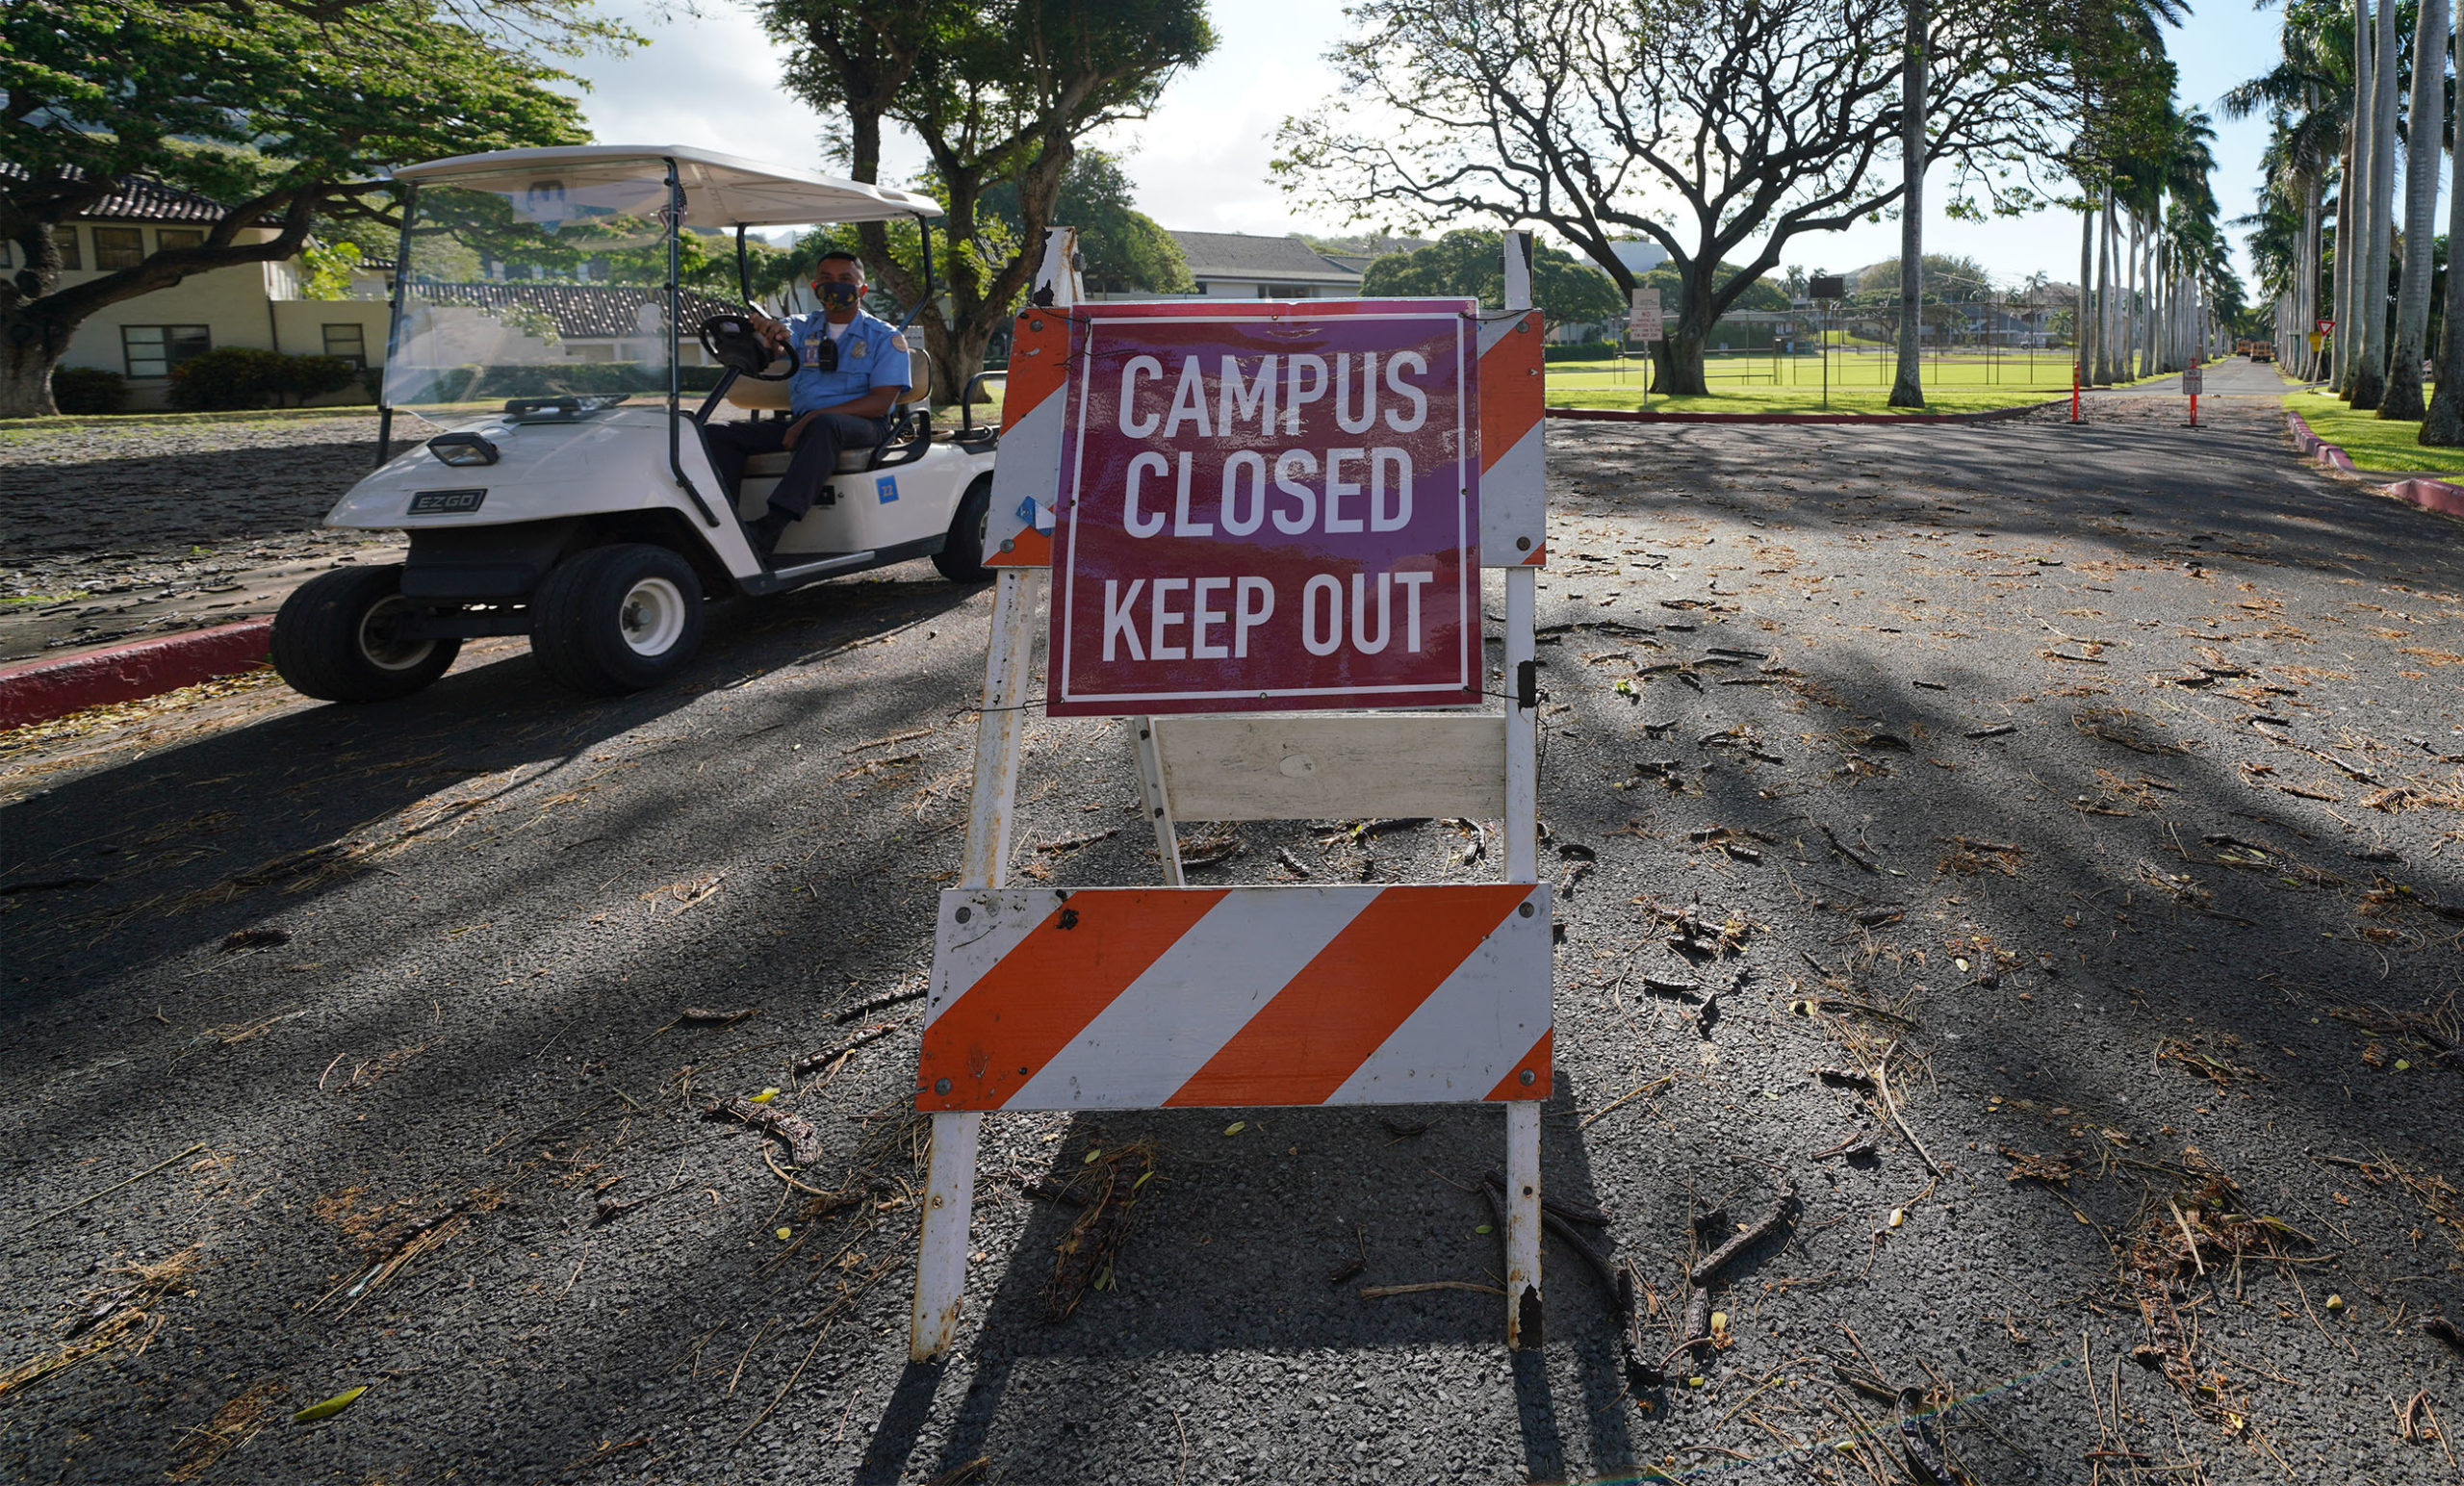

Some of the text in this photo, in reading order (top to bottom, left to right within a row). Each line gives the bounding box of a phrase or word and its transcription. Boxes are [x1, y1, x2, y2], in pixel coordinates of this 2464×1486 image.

[1117, 350, 1428, 439] CAMPUS
[417, 495, 475, 508] EZGO
[1123, 447, 1413, 539] CLOSED
[1102, 571, 1433, 662] KEEP OUT
